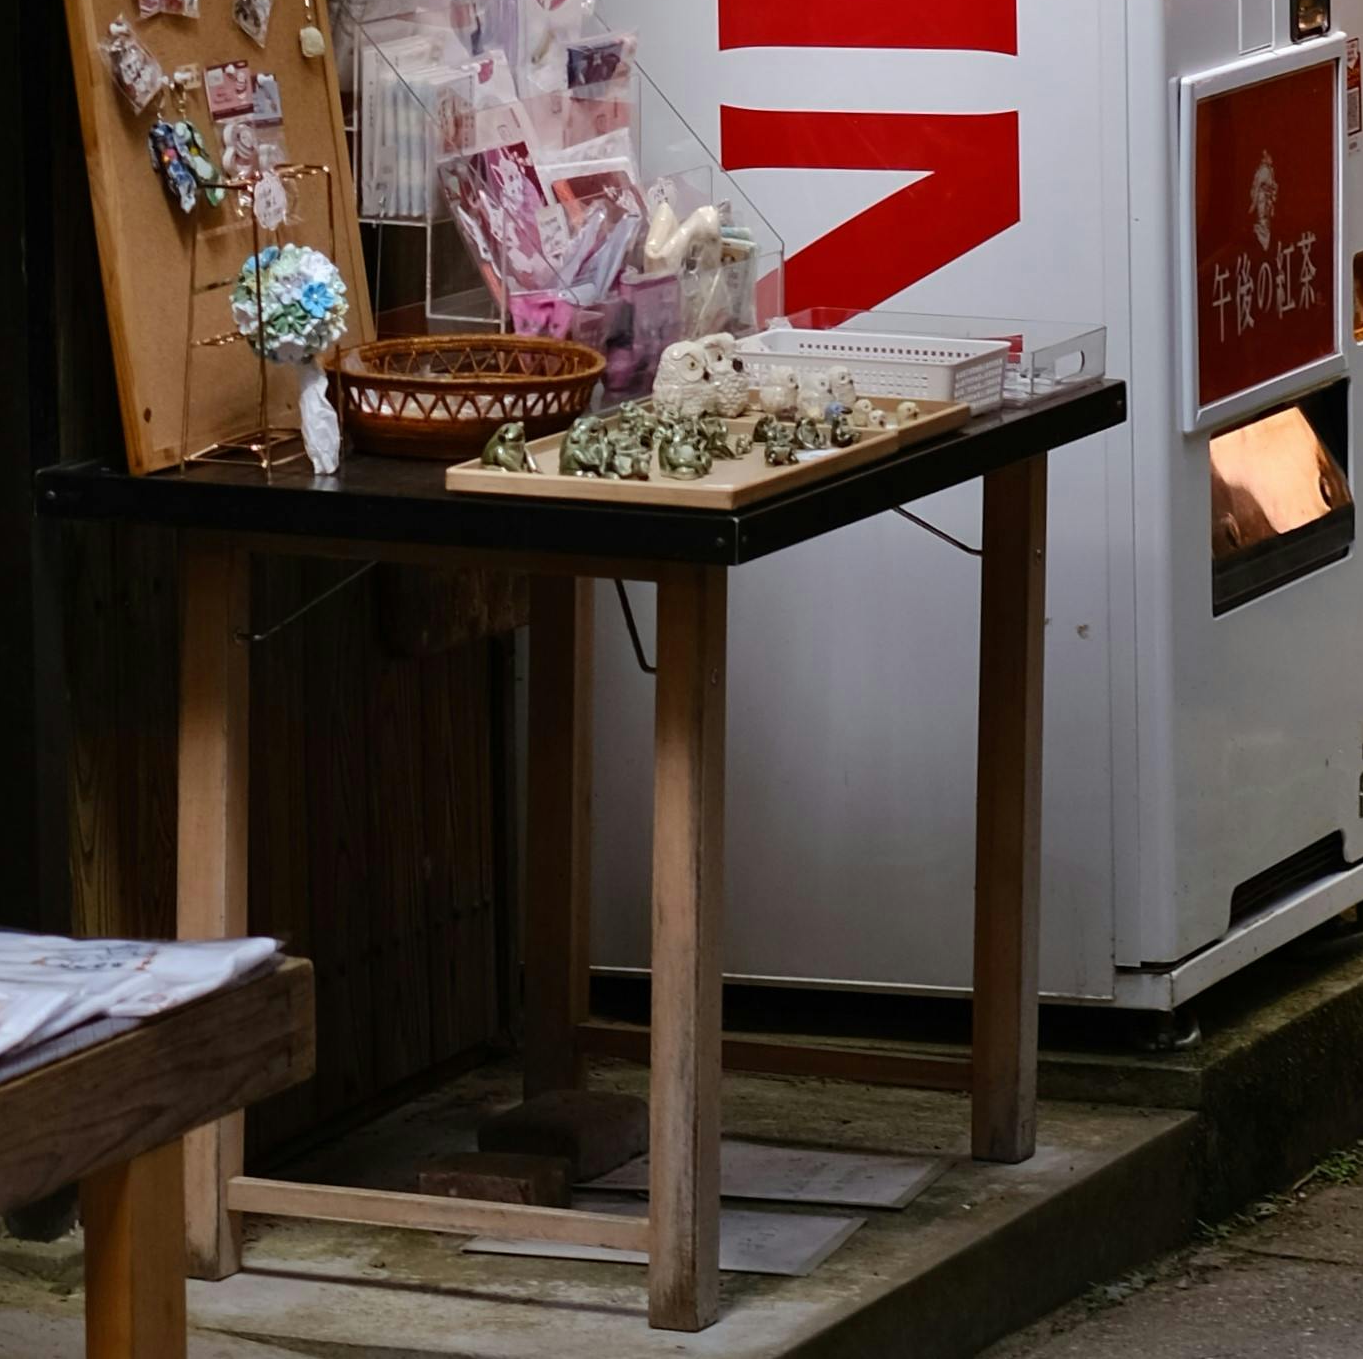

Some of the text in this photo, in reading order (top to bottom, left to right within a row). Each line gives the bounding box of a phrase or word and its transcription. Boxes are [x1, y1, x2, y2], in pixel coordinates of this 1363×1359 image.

[1211, 231, 1318, 344] 午後の紅茶
